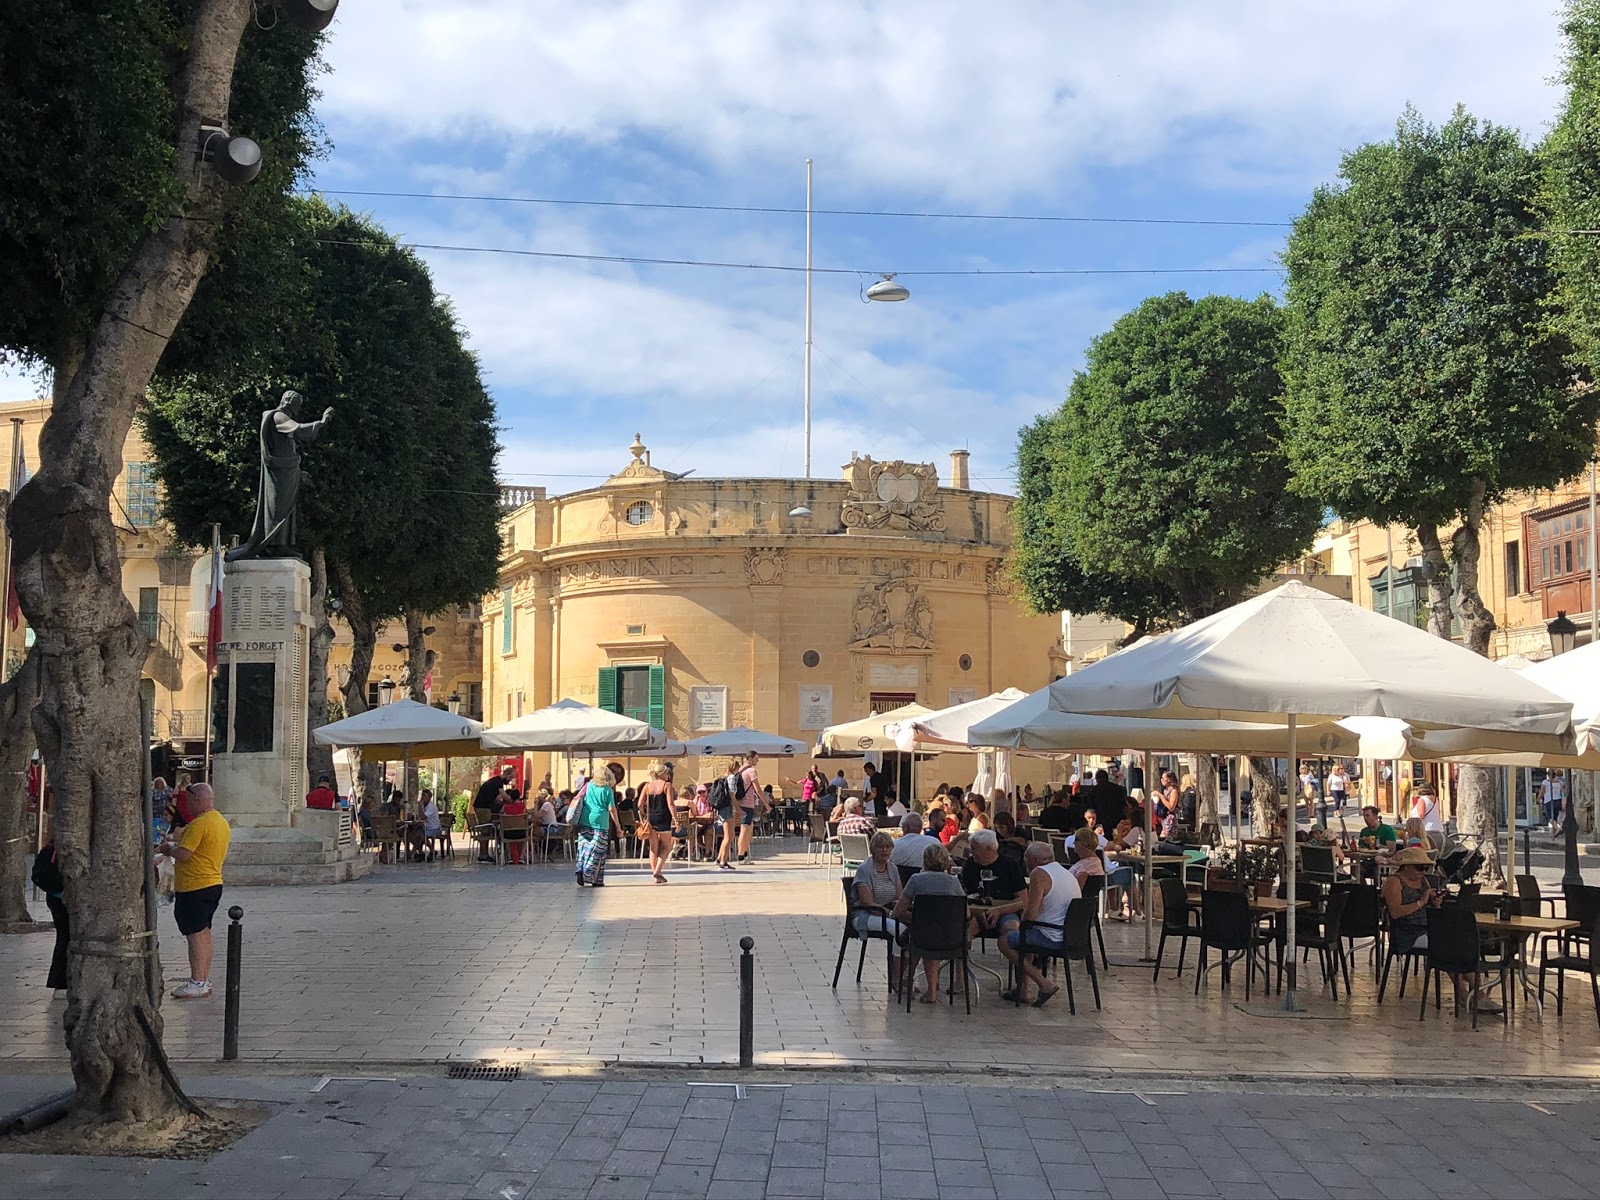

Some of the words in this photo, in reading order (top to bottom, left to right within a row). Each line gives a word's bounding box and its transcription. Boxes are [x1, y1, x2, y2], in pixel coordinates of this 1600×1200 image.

[246, 641, 284, 651] FORGET
[378, 664, 404, 672] GOZO
[871, 700, 911, 713] EXHIBITI
